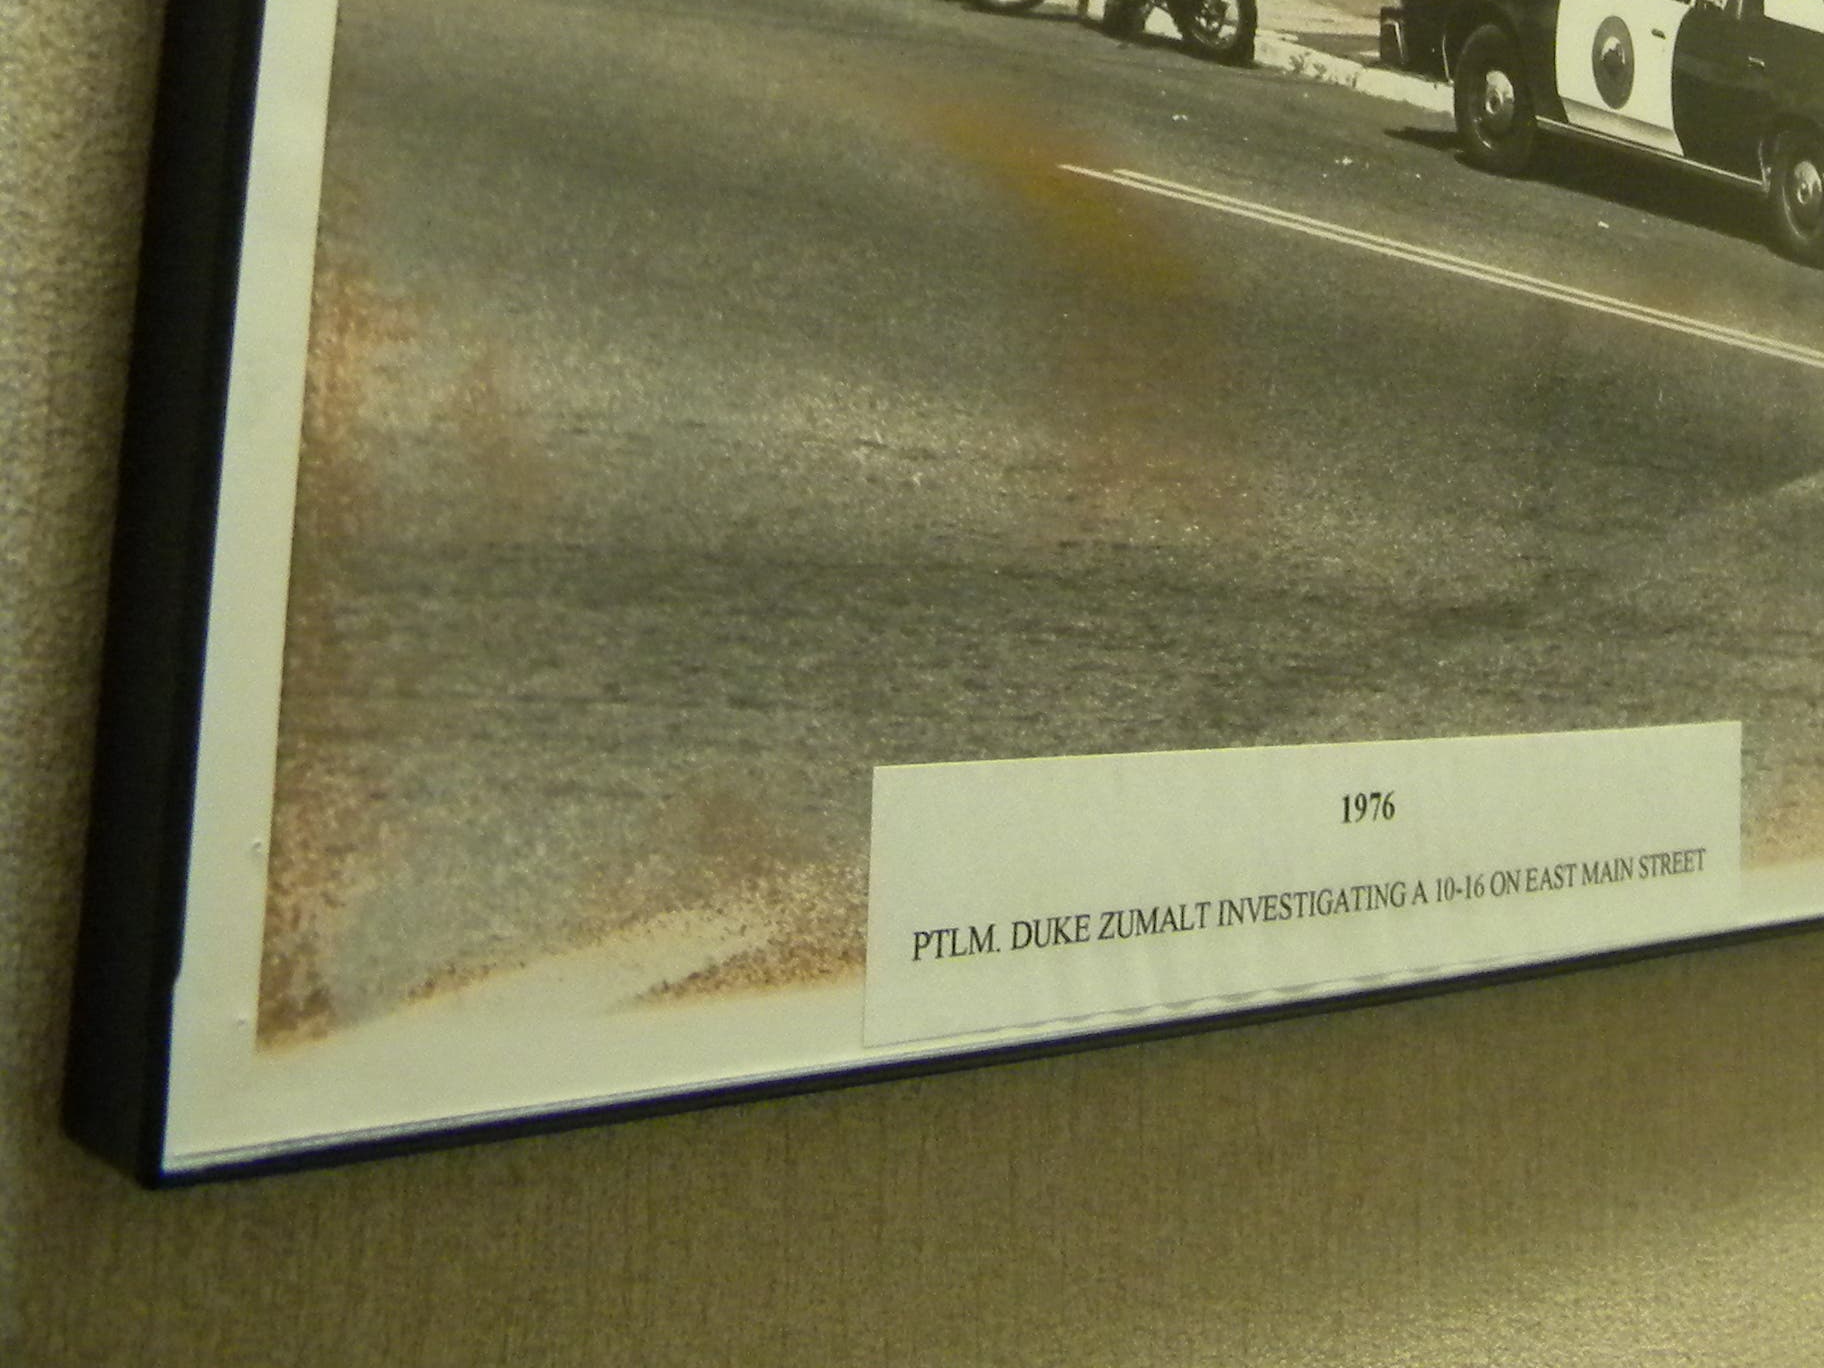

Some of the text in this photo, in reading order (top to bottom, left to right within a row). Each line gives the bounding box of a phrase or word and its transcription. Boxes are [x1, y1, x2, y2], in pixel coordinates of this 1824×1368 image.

[1341, 790, 1396, 824] 1976
[912, 847, 1706, 962] PTLM. DUKE ZUMALT INVESTIGATING A 10-16 ON EAST MAIN STREET
